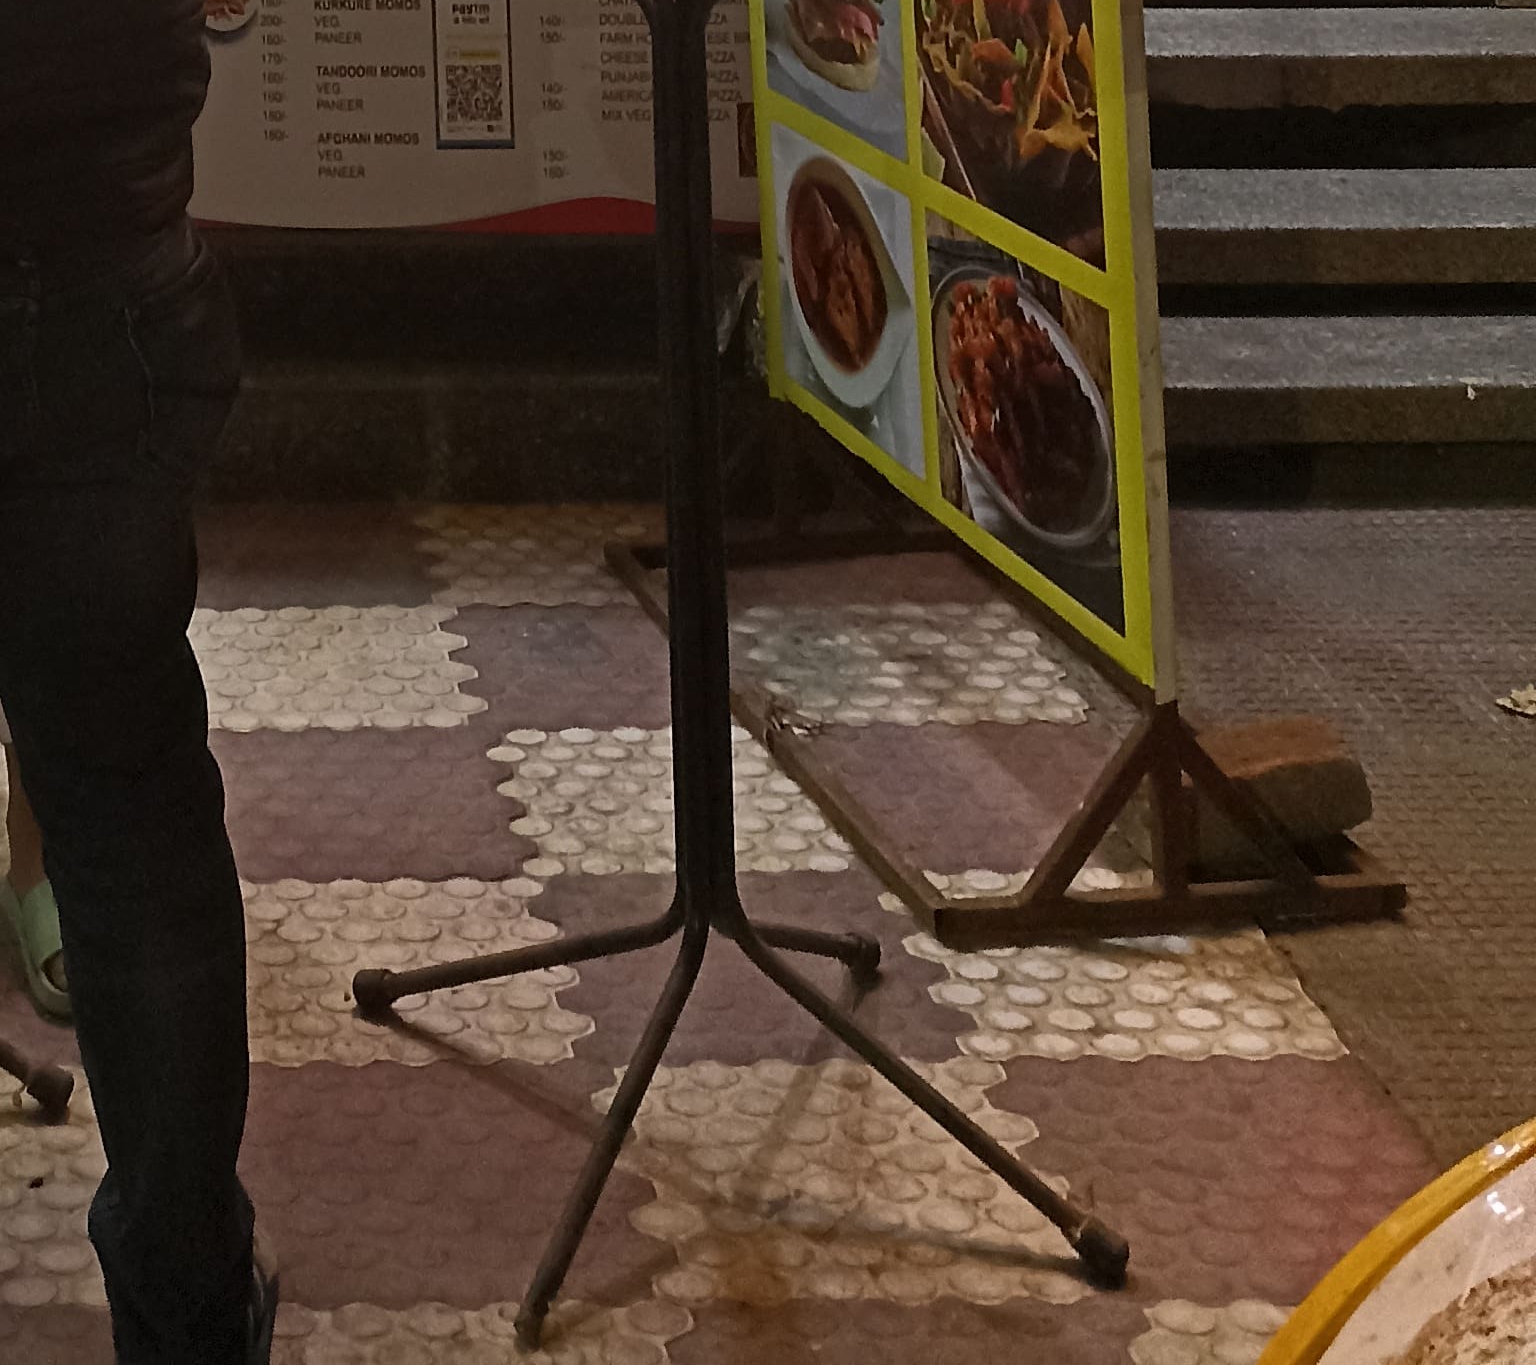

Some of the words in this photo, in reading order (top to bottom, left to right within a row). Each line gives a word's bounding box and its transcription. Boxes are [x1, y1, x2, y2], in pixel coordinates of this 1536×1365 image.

[314, 32, 361, 44] PANEER
[600, 32, 633, 44] FARM
[600, 51, 648, 63] CHEESE
[316, 65, 377, 78] TANDOORI
[380, 65, 426, 78] MOMOS
[317, 99, 364, 111] PANEER
[601, 109, 623, 121] MIX
[317, 133, 370, 145] AFGHANI
[374, 133, 420, 145] MOMOS
[318, 166, 365, 178] PANEER
